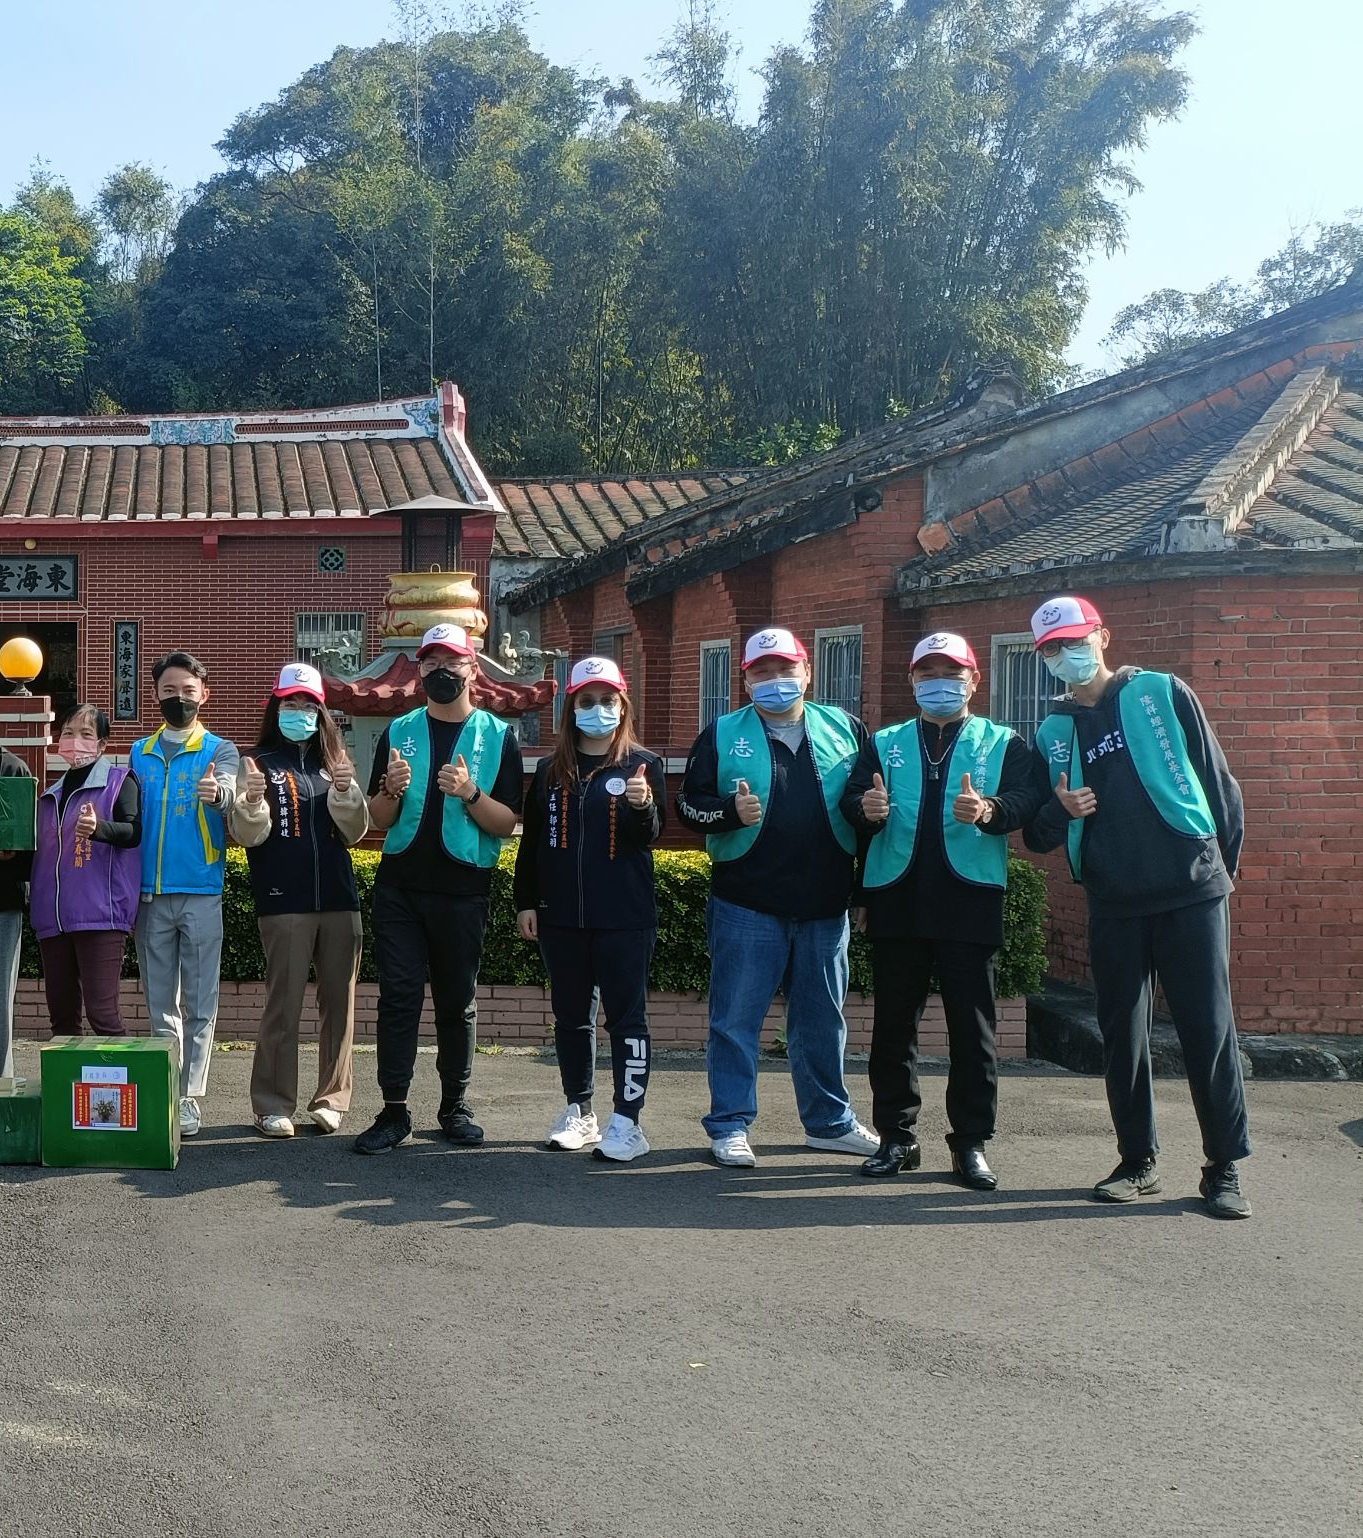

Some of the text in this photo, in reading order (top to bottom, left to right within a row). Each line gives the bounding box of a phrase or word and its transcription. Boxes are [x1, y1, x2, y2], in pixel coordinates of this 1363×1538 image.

[1139, 695, 1190, 796] 隆祥經濟發展基金會
[624, 1037, 647, 1102] FILA
